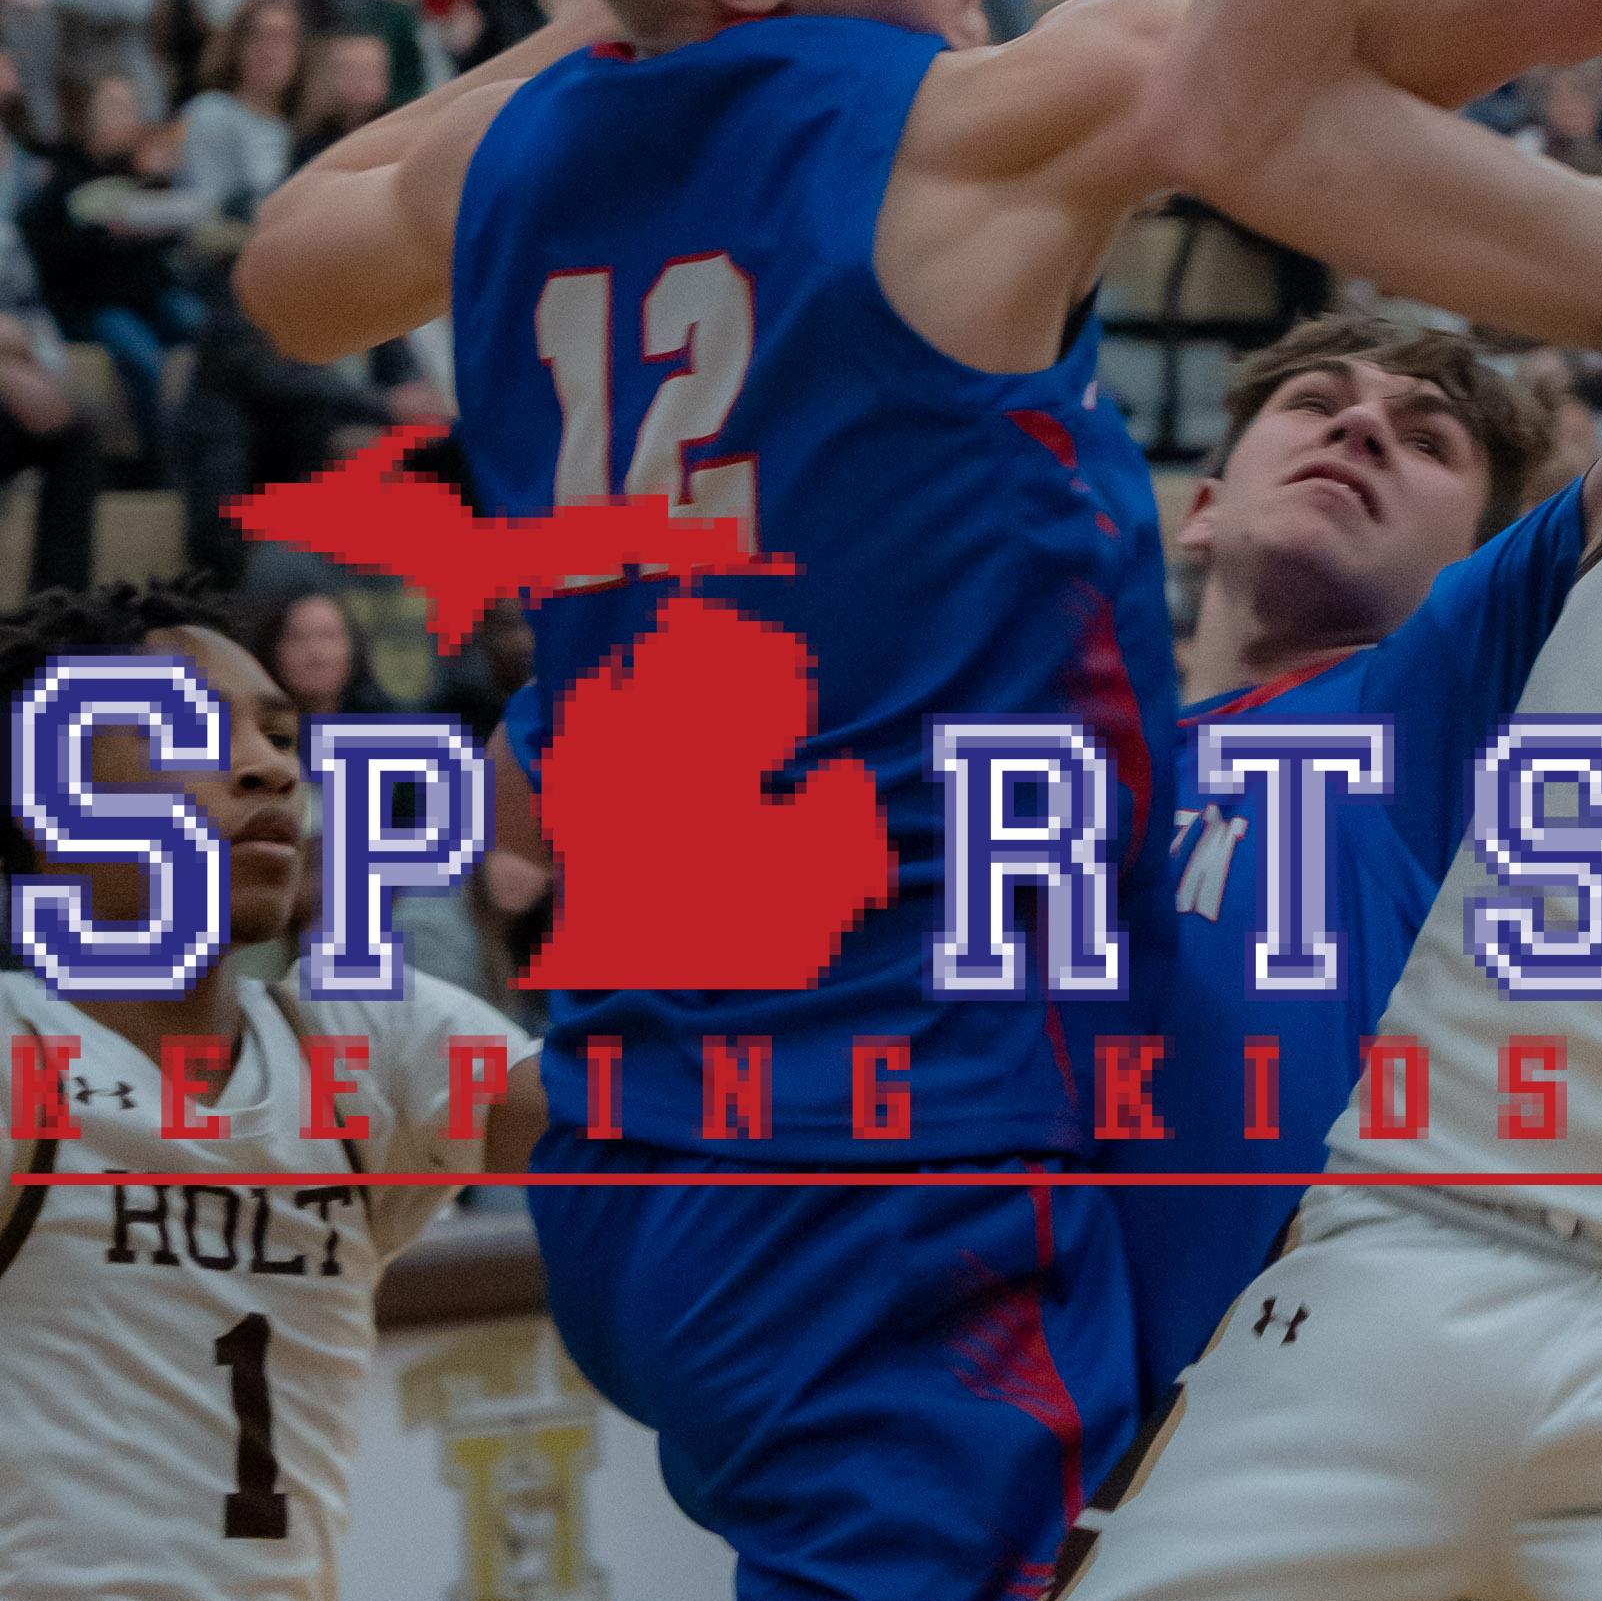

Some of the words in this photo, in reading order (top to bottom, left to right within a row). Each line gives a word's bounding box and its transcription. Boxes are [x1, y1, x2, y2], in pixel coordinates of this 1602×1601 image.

[534, 250, 760, 595] 12
[105, 1169, 352, 1276] HOLT
[214, 1312, 290, 1539] 1
